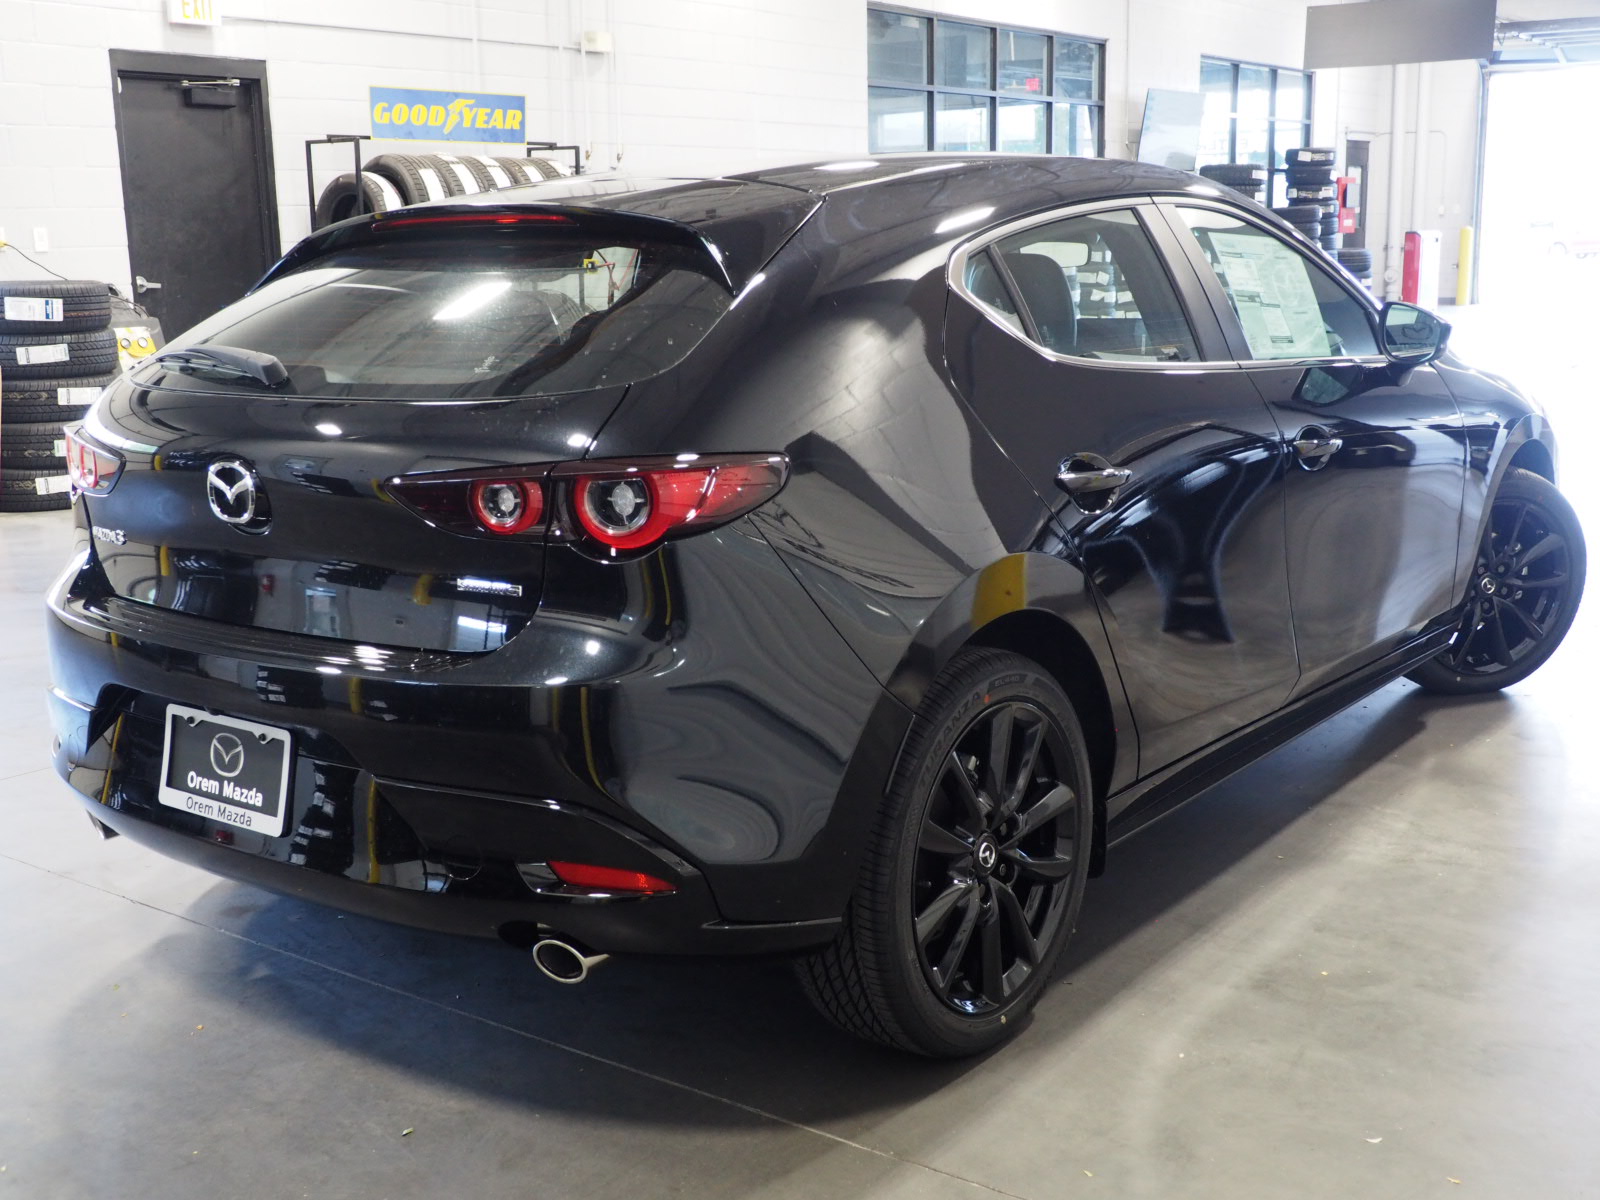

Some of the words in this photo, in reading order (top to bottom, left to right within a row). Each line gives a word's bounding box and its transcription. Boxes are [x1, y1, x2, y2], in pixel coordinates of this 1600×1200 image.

[373, 101, 523, 130] GOODYEAR
[187, 771, 220, 795] Orem
[222, 780, 263, 807] Mazda
[186, 796, 214, 817] Orem
[217, 805, 252, 827] Mazda
